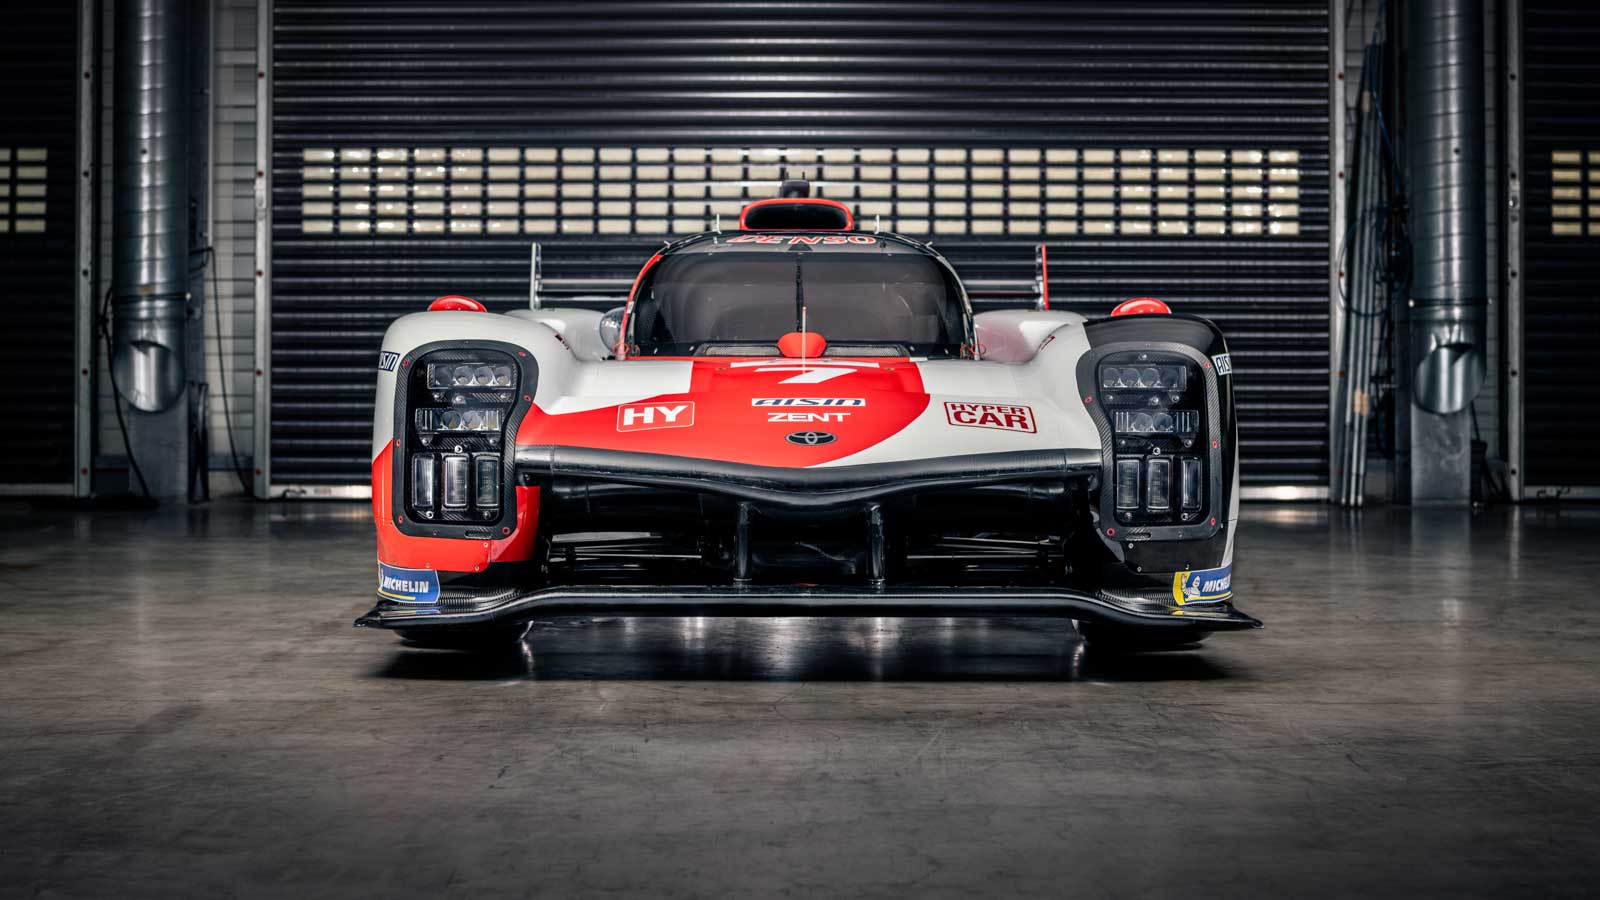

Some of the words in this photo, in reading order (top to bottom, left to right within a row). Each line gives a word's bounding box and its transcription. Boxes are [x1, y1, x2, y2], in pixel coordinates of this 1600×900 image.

[726, 234, 876, 244] DENSO
[951, 403, 1025, 415] HYPER
[623, 405, 689, 426] HY
[767, 412, 851, 422] ZENT
[953, 411, 1029, 429] CAR
